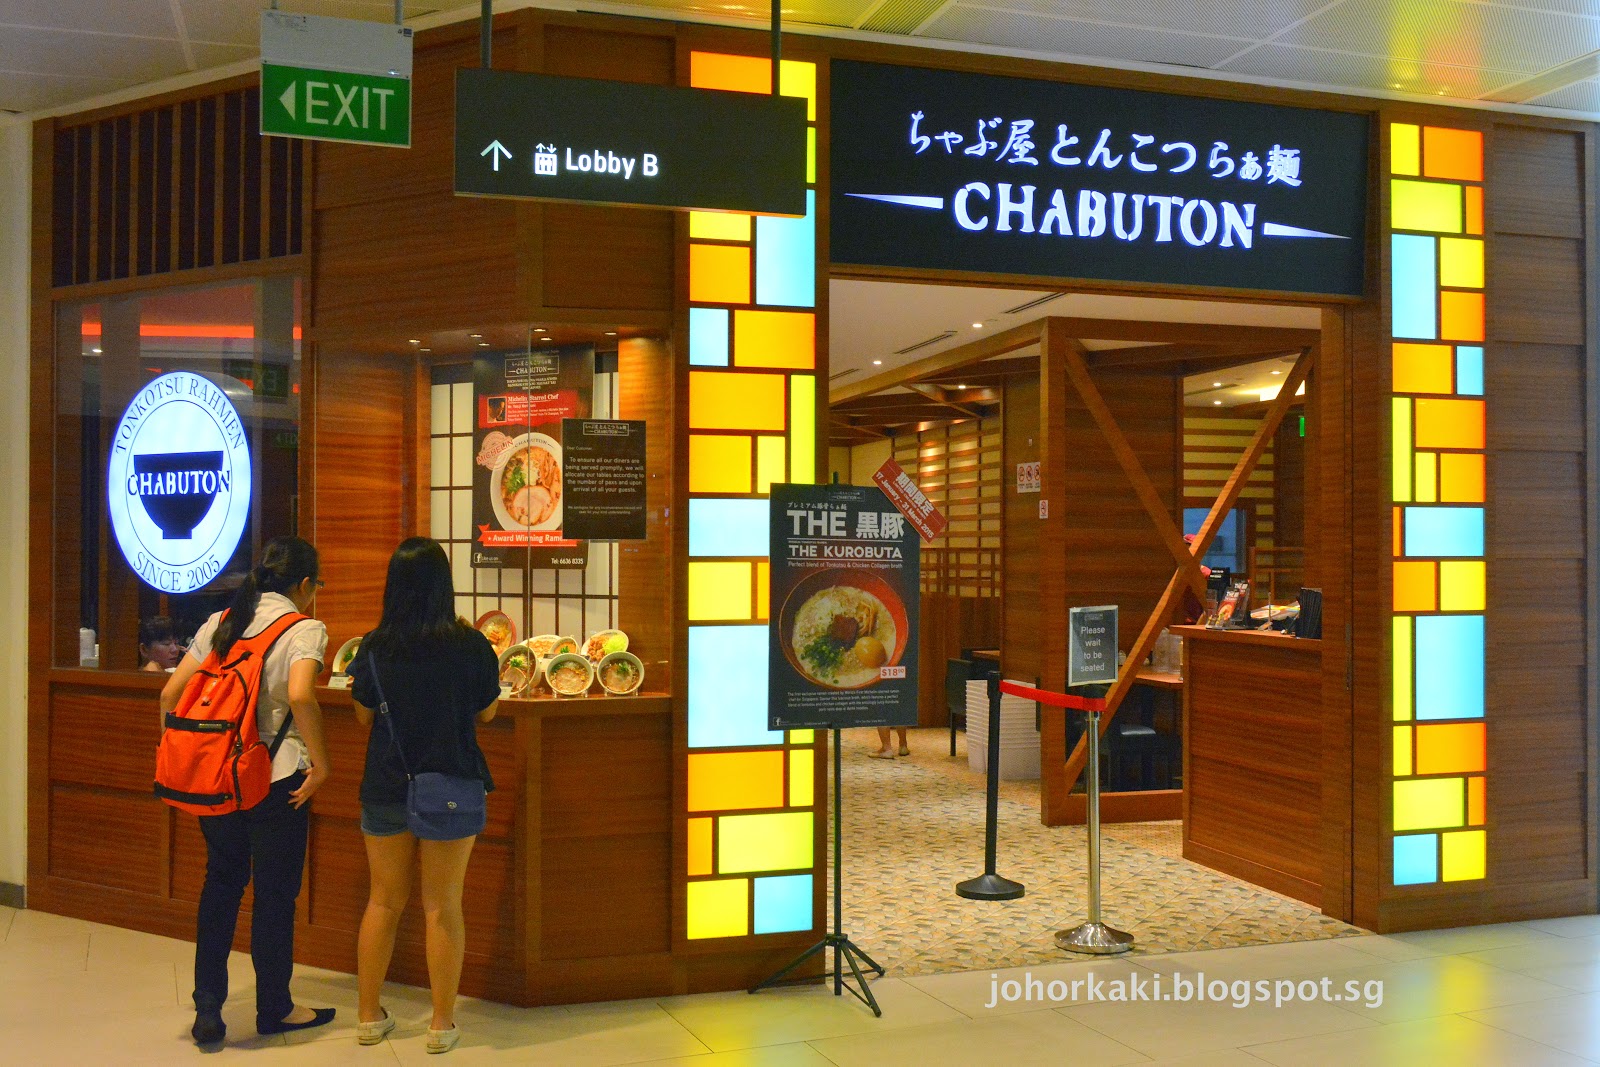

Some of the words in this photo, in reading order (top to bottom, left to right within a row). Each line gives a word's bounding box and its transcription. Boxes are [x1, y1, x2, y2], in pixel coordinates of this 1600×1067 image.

[306, 80, 394, 130] EXIT
[566, 147, 636, 180] Lobby
[643, 153, 658, 176] B
[910, 110, 1038, 166] ちゃぶ屋
[1051, 124, 1197, 172] とんこつ
[1209, 141, 1302, 187] らぁ麺
[954, 181, 1256, 249] CHABUTON
[116, 376, 184, 454] TONKOTSU
[188, 377, 244, 450] RAHMEN
[127, 470, 230, 496] CHABUTON
[787, 510, 846, 536] THE
[856, 512, 904, 539] 黒豚
[881, 480, 900, 500] January
[908, 508, 922, 526] March
[921, 524, 934, 538] 2015
[788, 545, 817, 557] THE
[824, 546, 902, 558] KUROBUTA
[133, 551, 182, 592] SINCE
[187, 554, 220, 590] 2005
[1085, 638, 1101, 646] wait
[1080, 663, 1105, 672] seated
